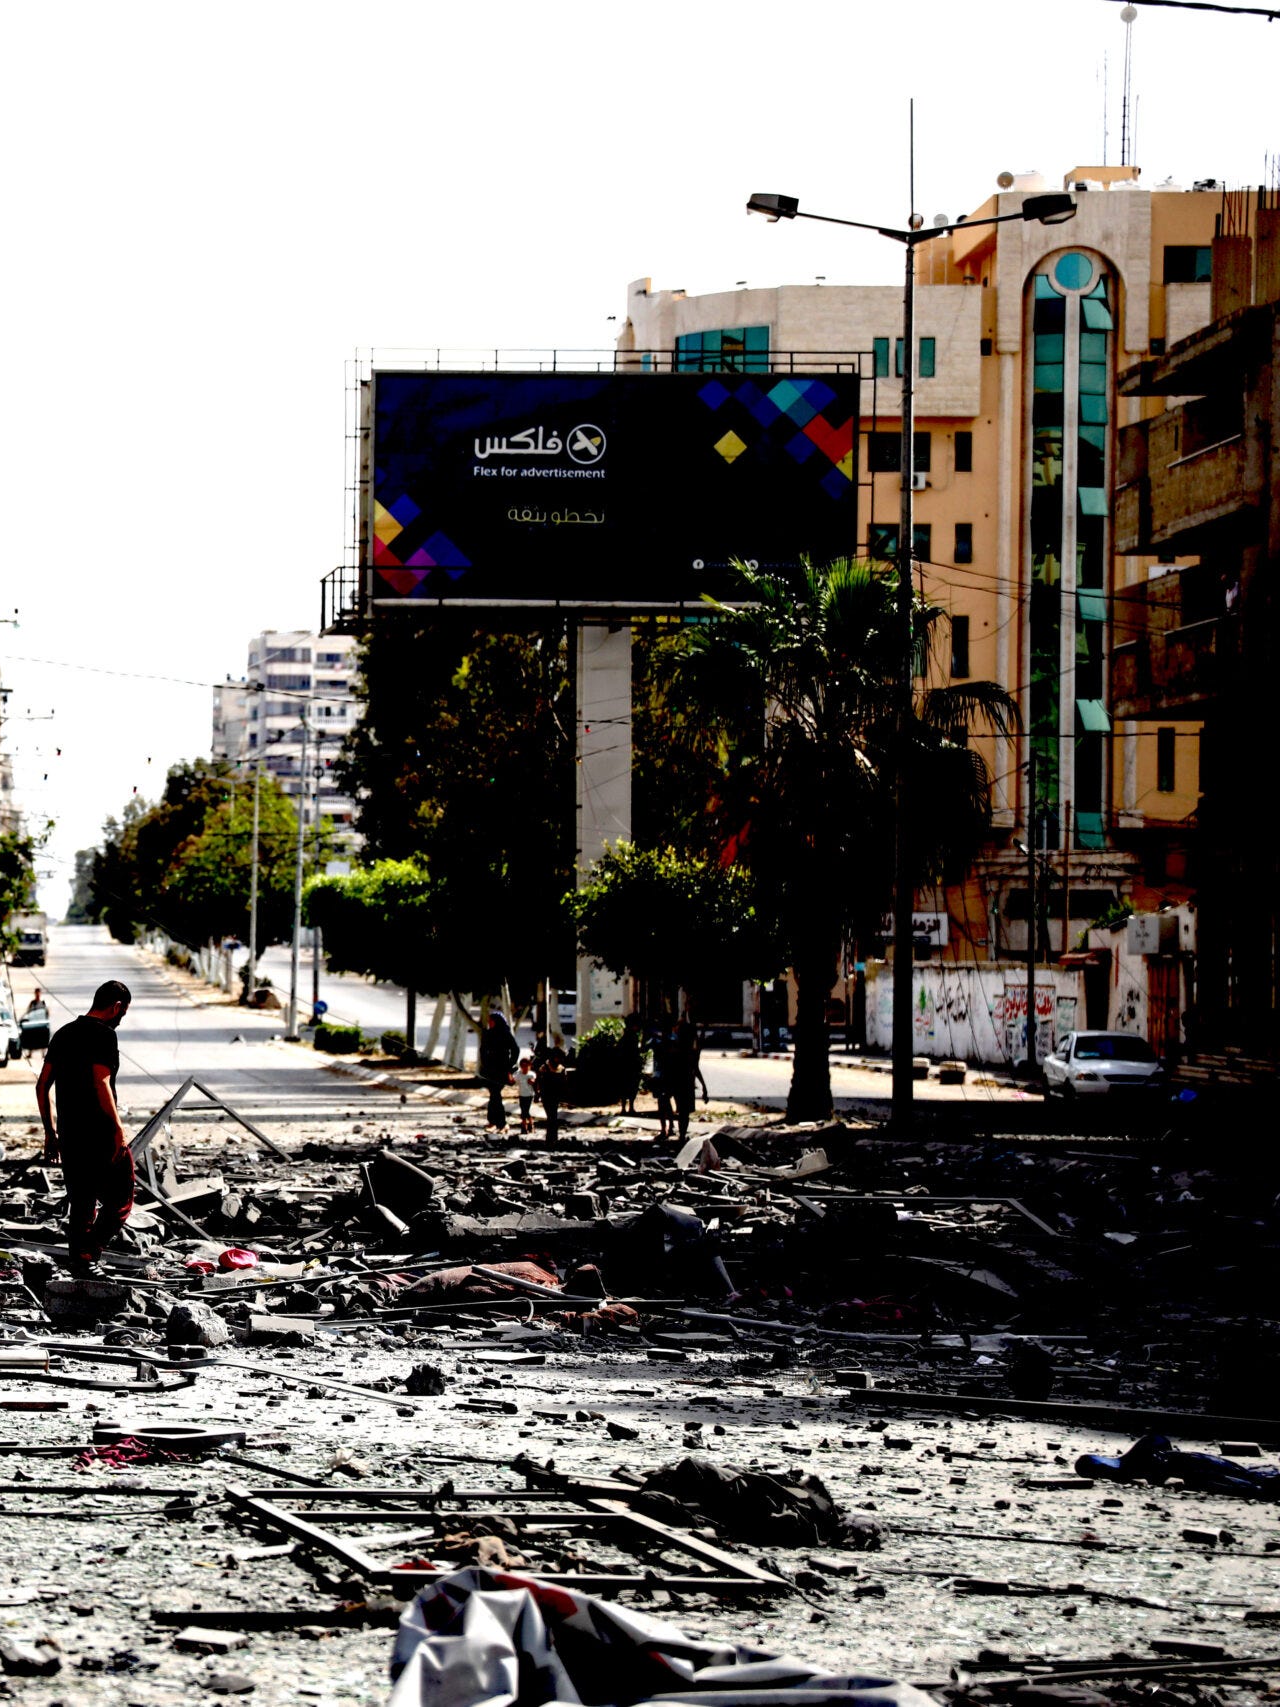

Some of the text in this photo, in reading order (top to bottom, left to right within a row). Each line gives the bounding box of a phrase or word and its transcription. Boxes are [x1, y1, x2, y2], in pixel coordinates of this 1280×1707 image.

[474, 425, 563, 459] فلكس
[473, 465, 606, 479] Flex for advertisement
[507, 505, 547, 526] بثقة
